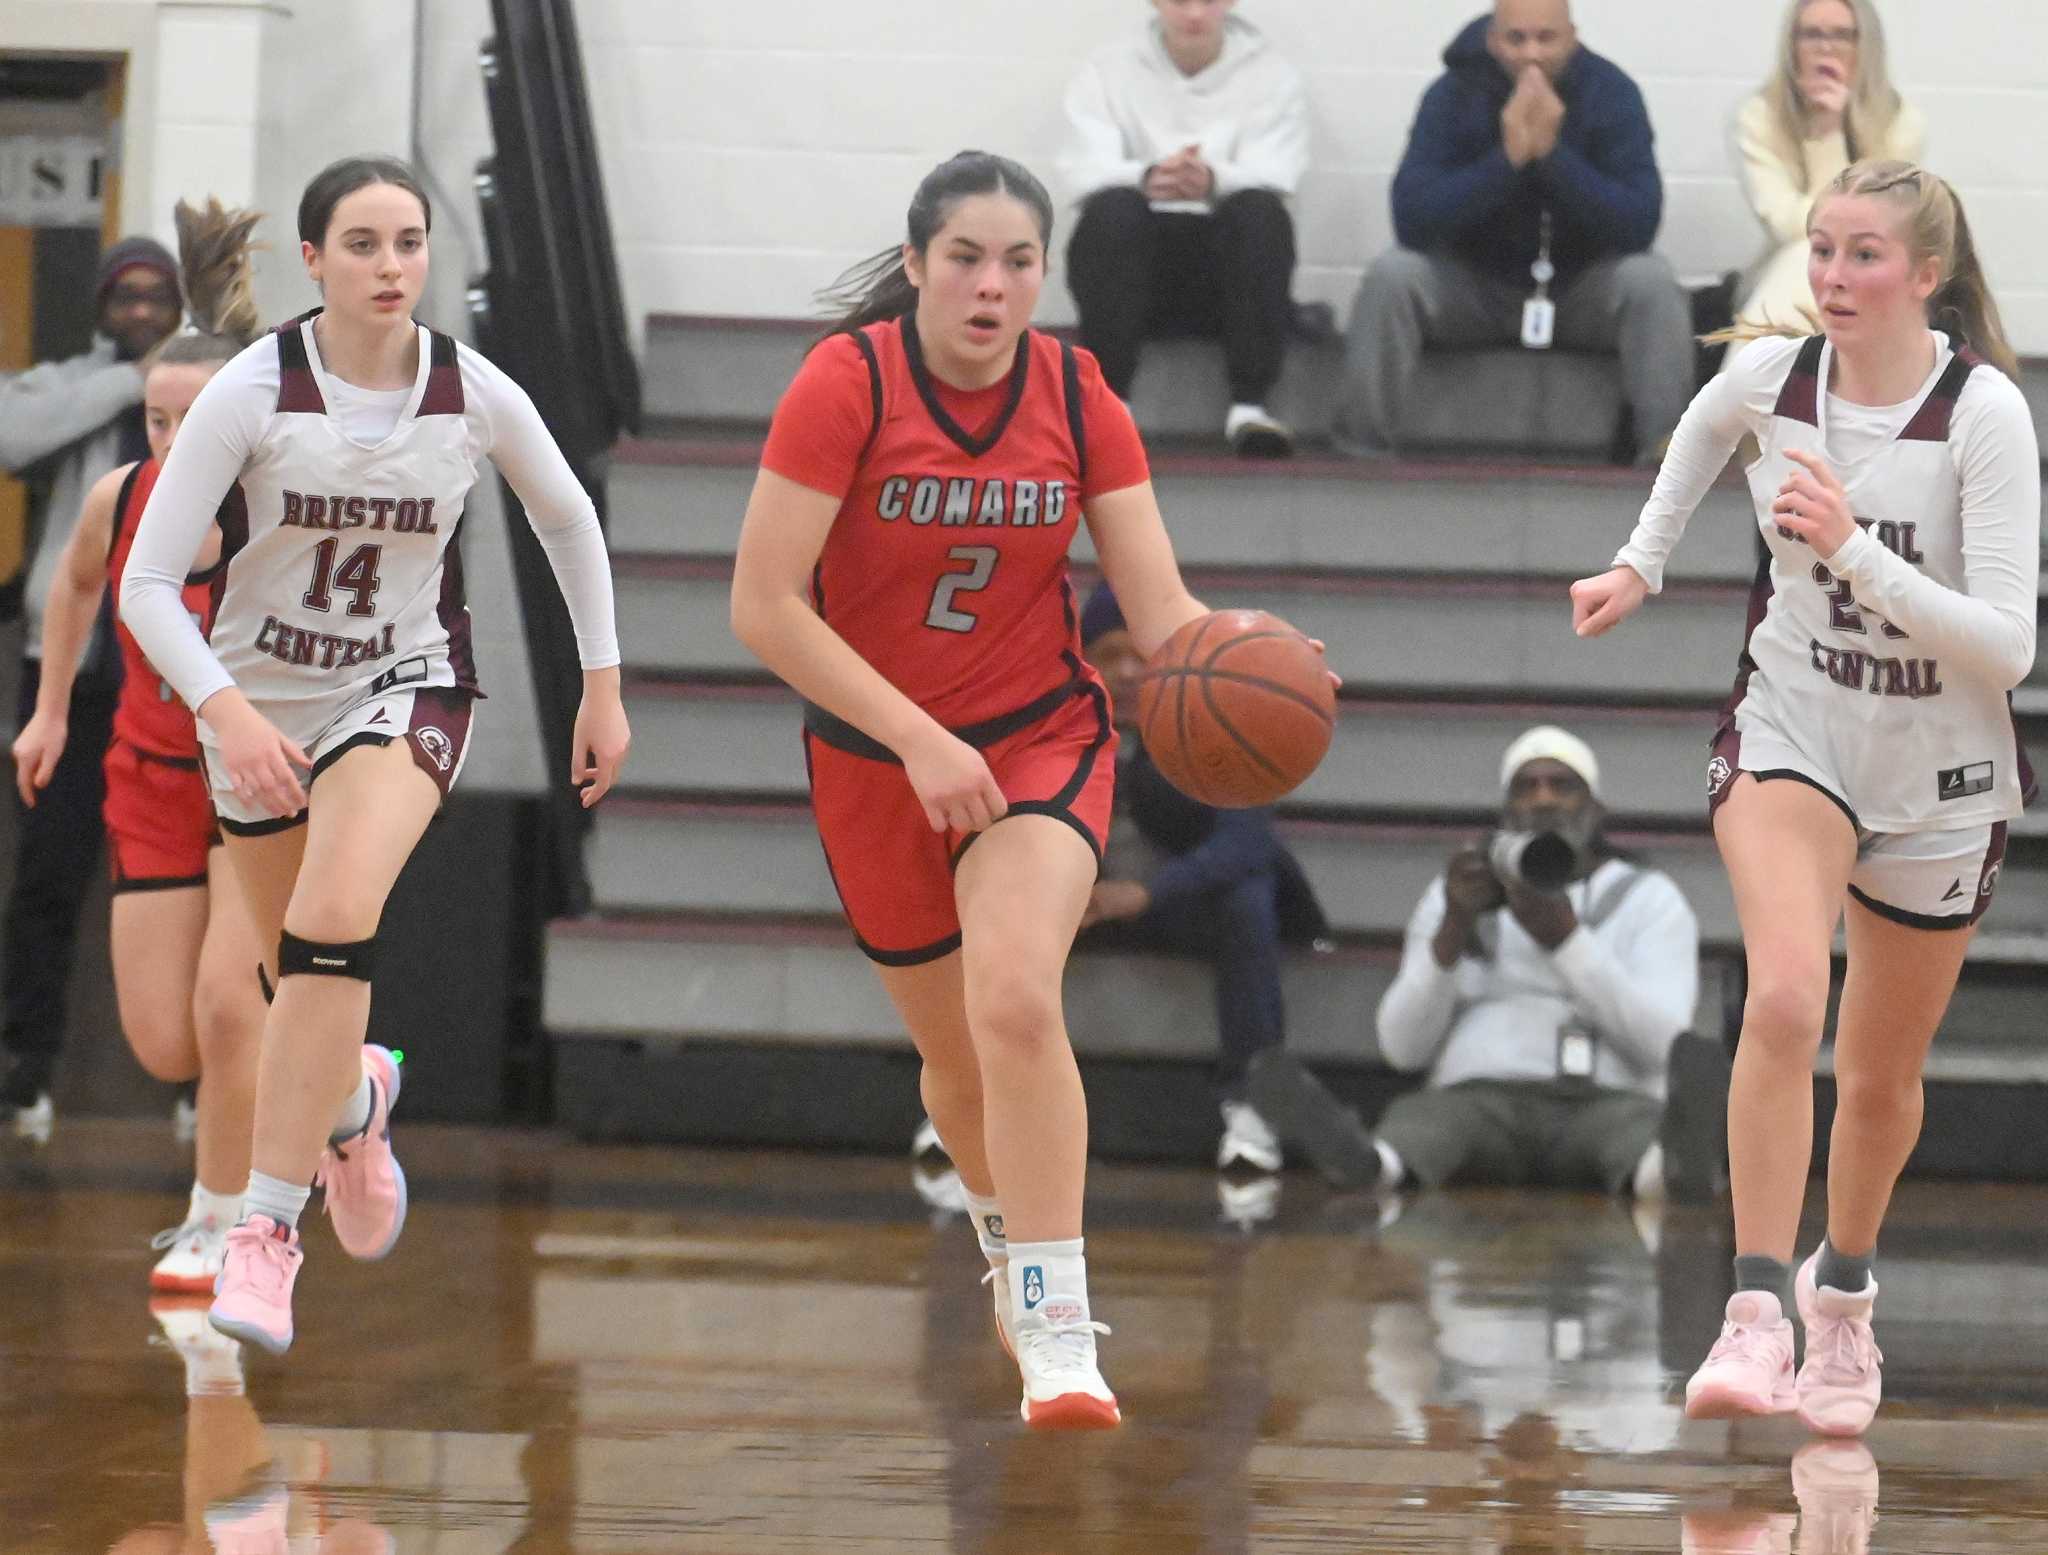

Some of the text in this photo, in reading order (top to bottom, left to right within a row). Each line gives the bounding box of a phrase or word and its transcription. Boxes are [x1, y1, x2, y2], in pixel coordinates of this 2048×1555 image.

[279, 489, 438, 535] BRISTOL
[877, 474, 1066, 527] CONARD
[302, 537, 383, 617] 14
[924, 545, 999, 634] 2
[1812, 561, 1909, 639] 2
[255, 615, 395, 669] CENTRAL
[1809, 638, 1942, 699] CENTRAL
